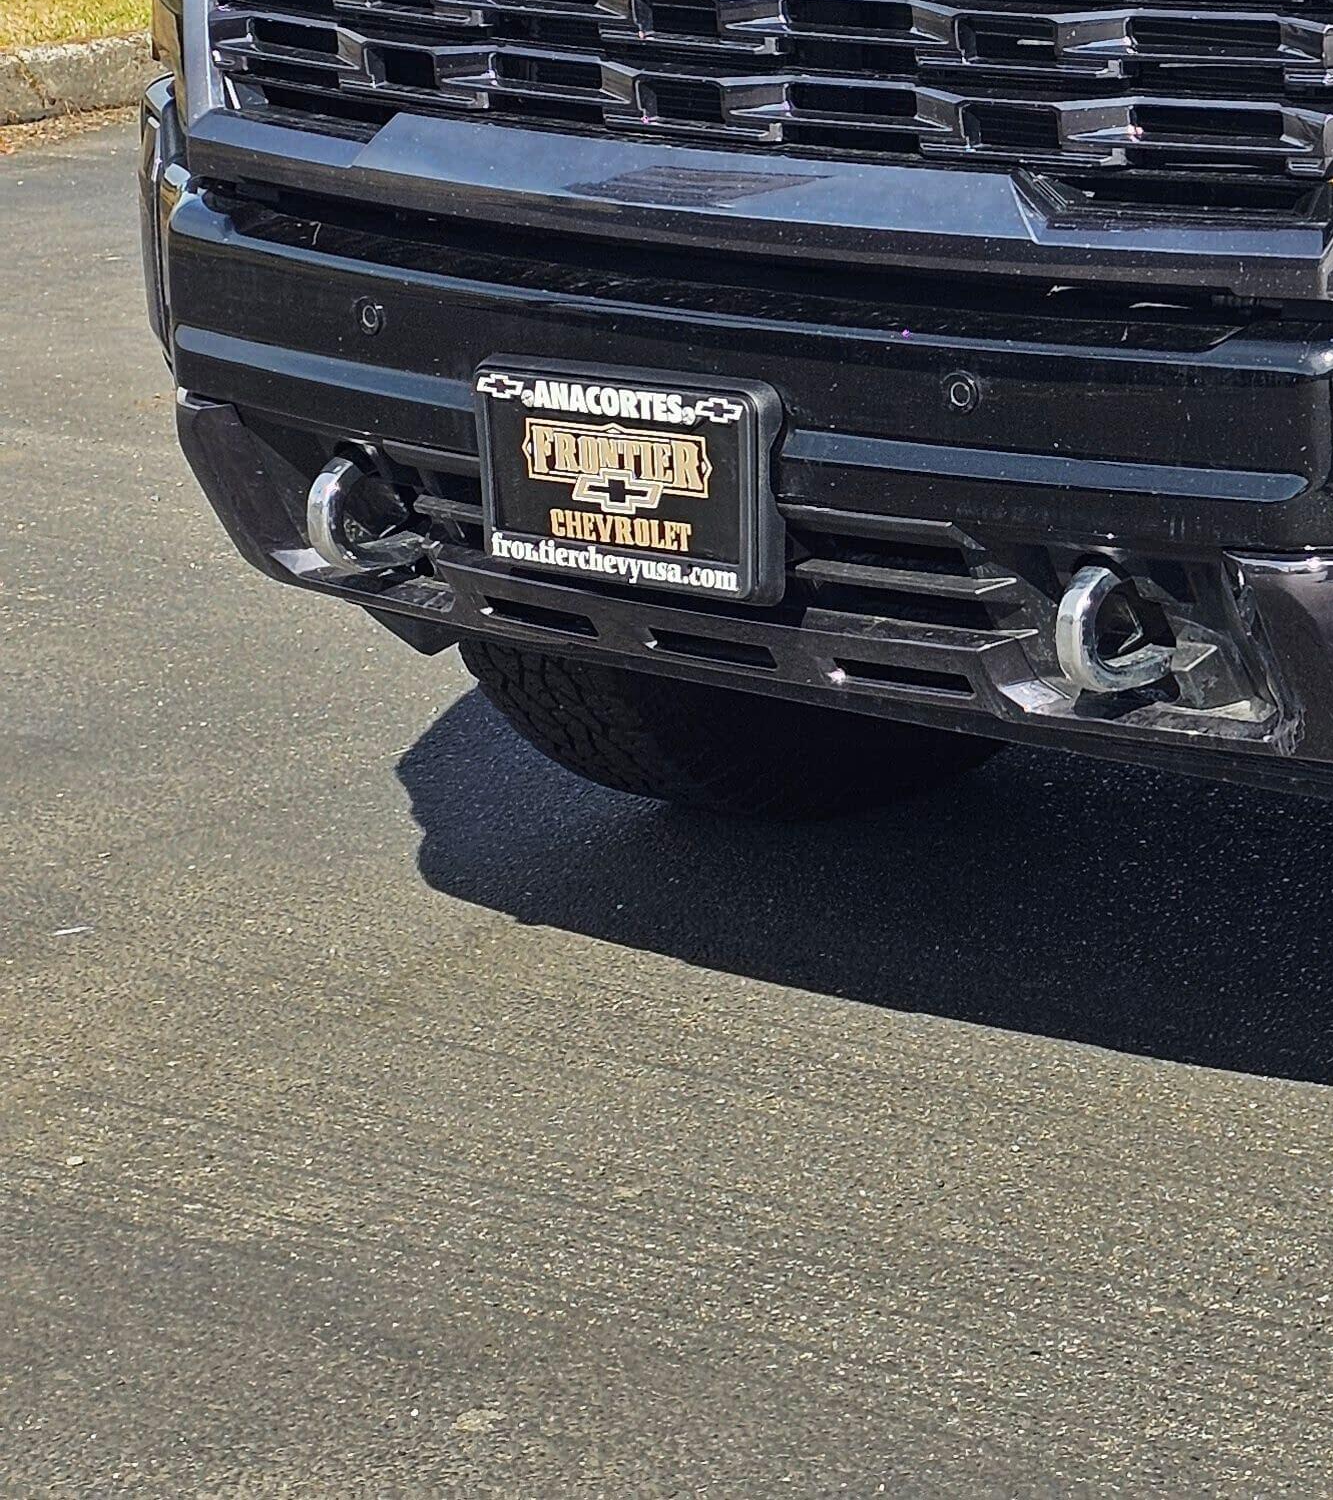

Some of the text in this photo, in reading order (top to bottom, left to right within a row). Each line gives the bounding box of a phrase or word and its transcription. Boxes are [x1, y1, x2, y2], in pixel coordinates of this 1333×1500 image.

[530, 380, 683, 425] ANACORTES
[531, 425, 702, 491] FRONTIER
[549, 508, 692, 553] CHEVROLET
[491, 532, 740, 593] frontierchevyusa.com
